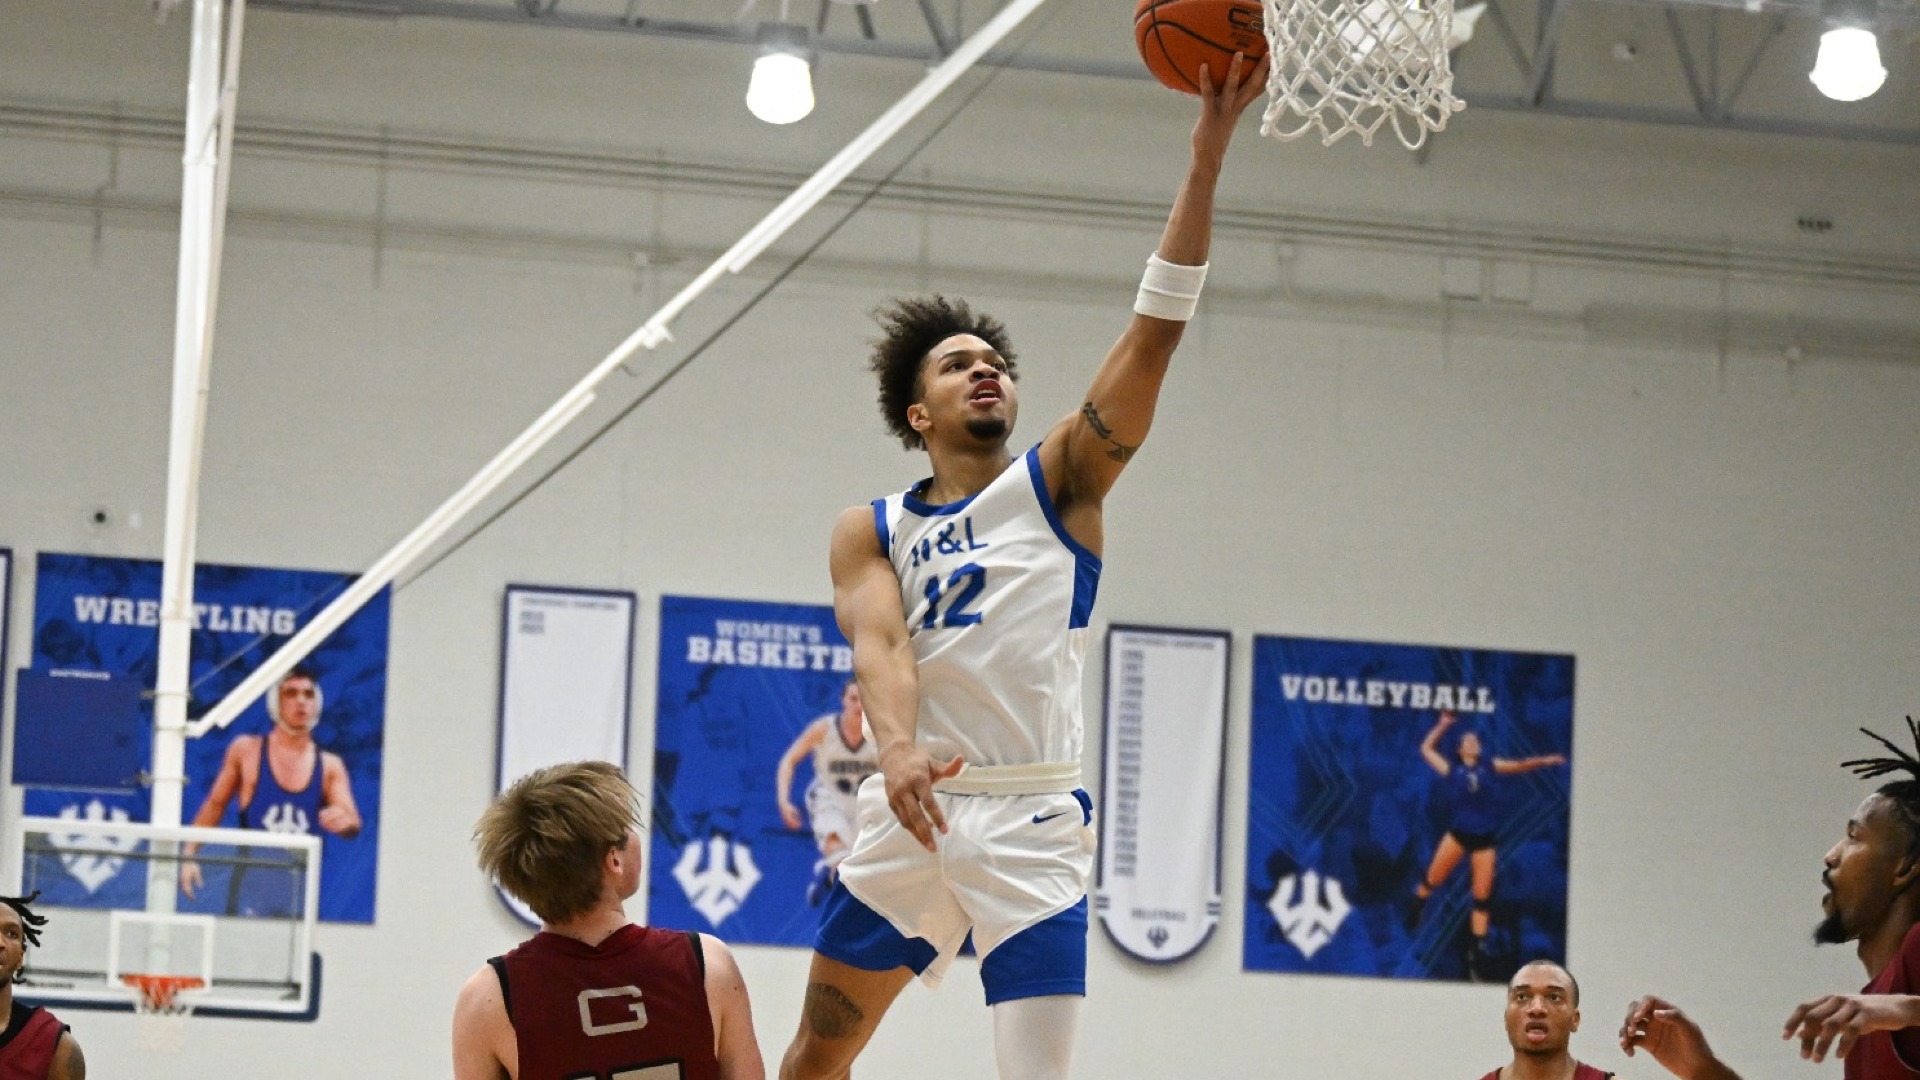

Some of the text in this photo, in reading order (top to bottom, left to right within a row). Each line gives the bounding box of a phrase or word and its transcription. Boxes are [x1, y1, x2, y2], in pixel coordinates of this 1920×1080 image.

[74, 595, 297, 635] WRETLING
[923, 562, 987, 630] 12
[1281, 673, 1496, 714] VOLLEYBALL
[577, 985, 648, 1037] G
